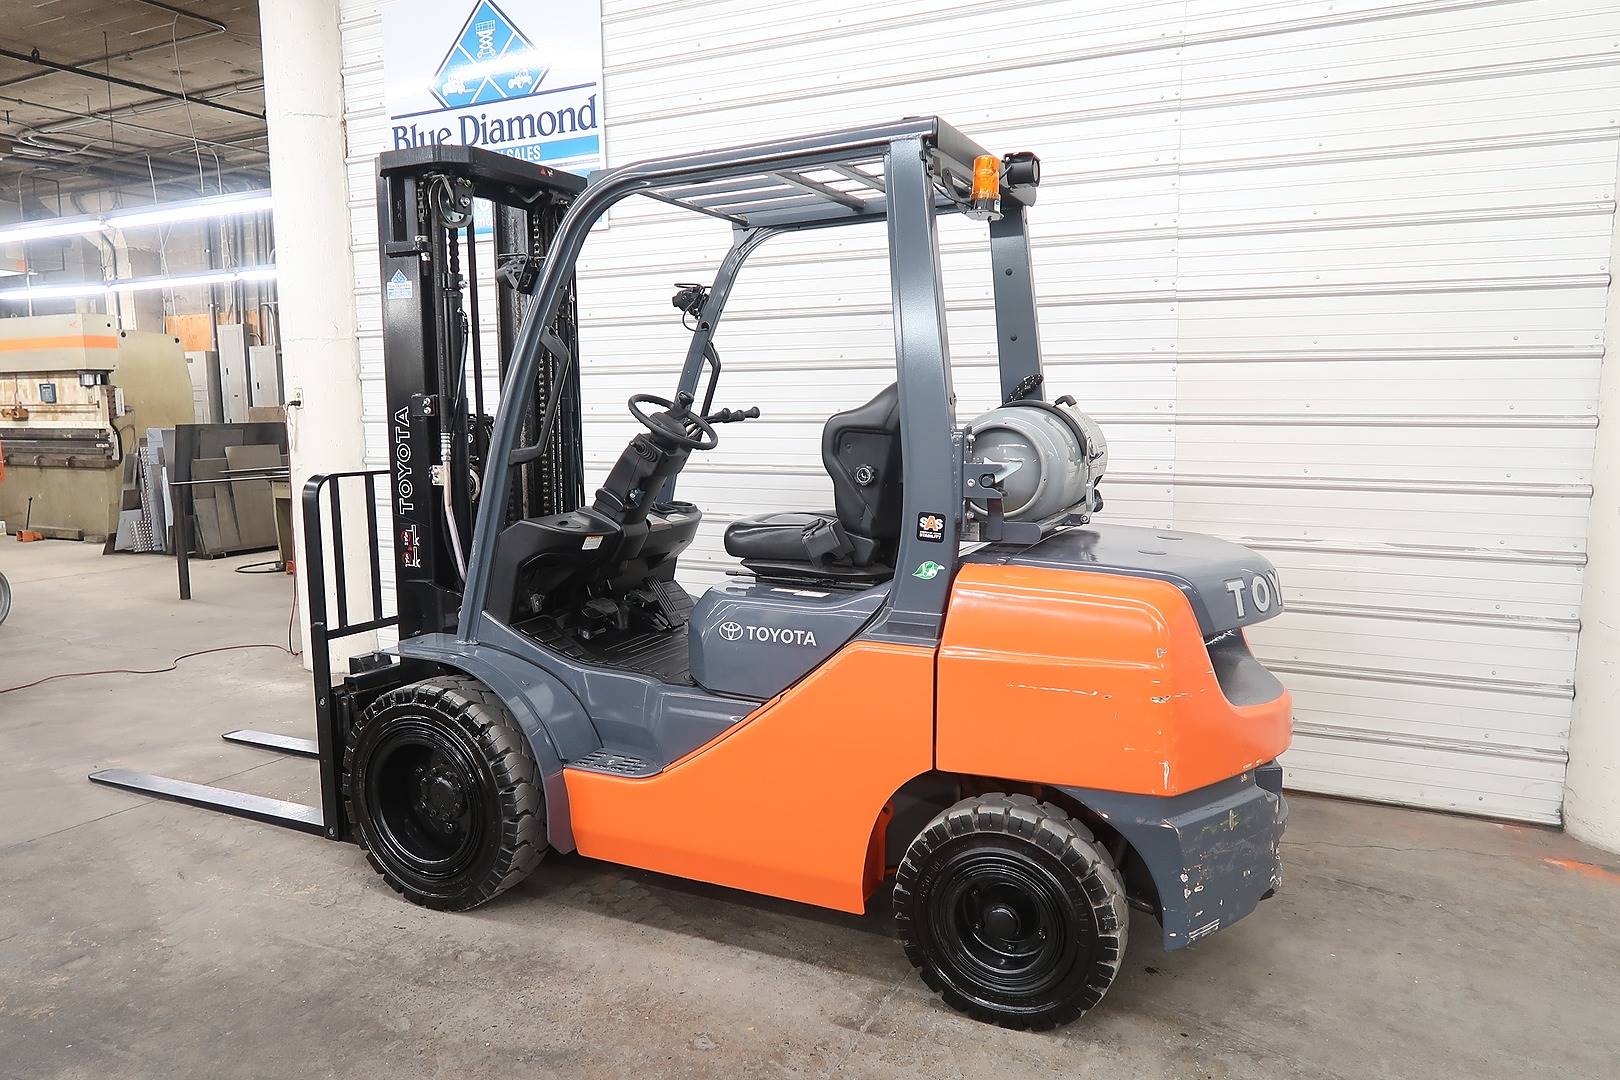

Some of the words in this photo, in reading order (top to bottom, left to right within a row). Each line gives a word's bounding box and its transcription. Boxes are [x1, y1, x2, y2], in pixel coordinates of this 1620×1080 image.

[393, 123, 452, 151] Blue
[458, 94, 598, 147] Diamond
[395, 406, 414, 515] TOYOTA
[919, 515, 944, 531] SAS
[746, 625, 817, 647] TOYOTA
